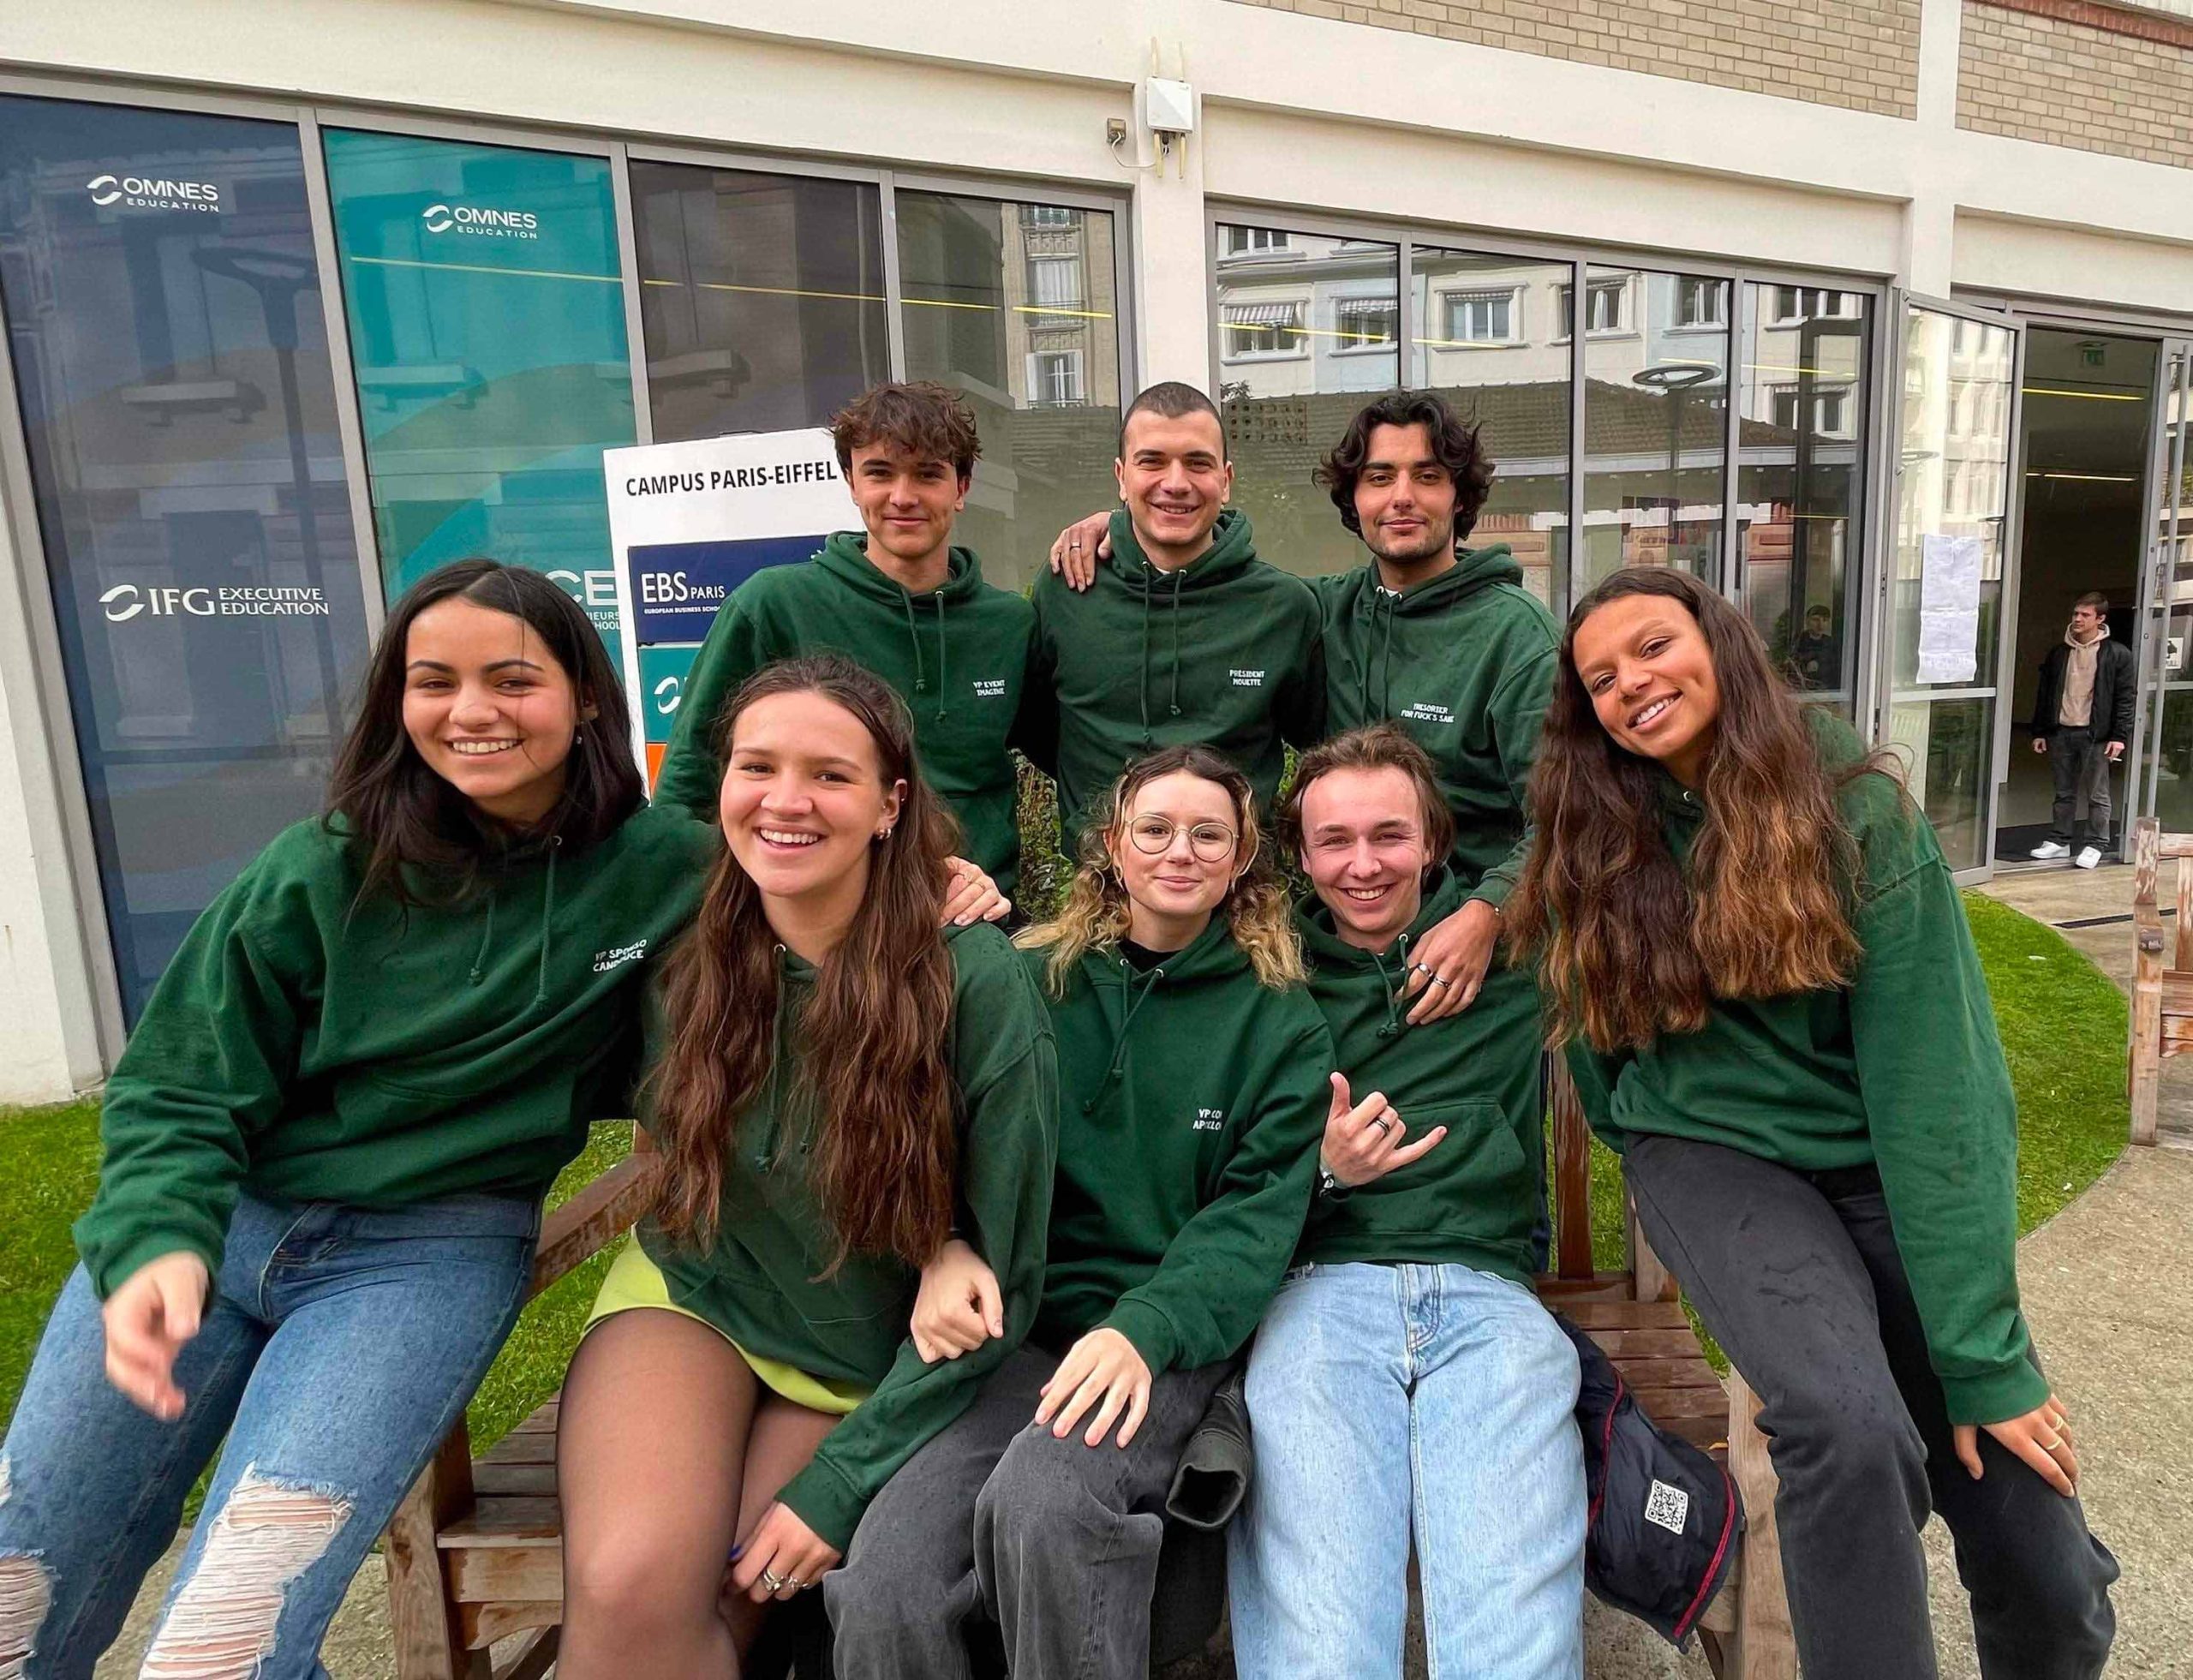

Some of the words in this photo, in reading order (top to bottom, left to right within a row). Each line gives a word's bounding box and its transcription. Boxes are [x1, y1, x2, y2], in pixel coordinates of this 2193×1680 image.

[122, 177, 219, 201] OMNES
[127, 197, 220, 212] EDUCATION
[454, 206, 537, 229] OMNES
[457, 225, 538, 239] EDUCATION
[626, 472, 705, 496] CAMPUS
[710, 461, 838, 489] PARIS-EIFFEL
[641, 571, 688, 603] EBS
[690, 585, 726, 600] PARIS
[148, 588, 215, 615] IFG
[218, 587, 324, 601] EXECUTIVE
[221, 601, 330, 615] EDUCATION
[1198, 1109, 1211, 1118] VP
